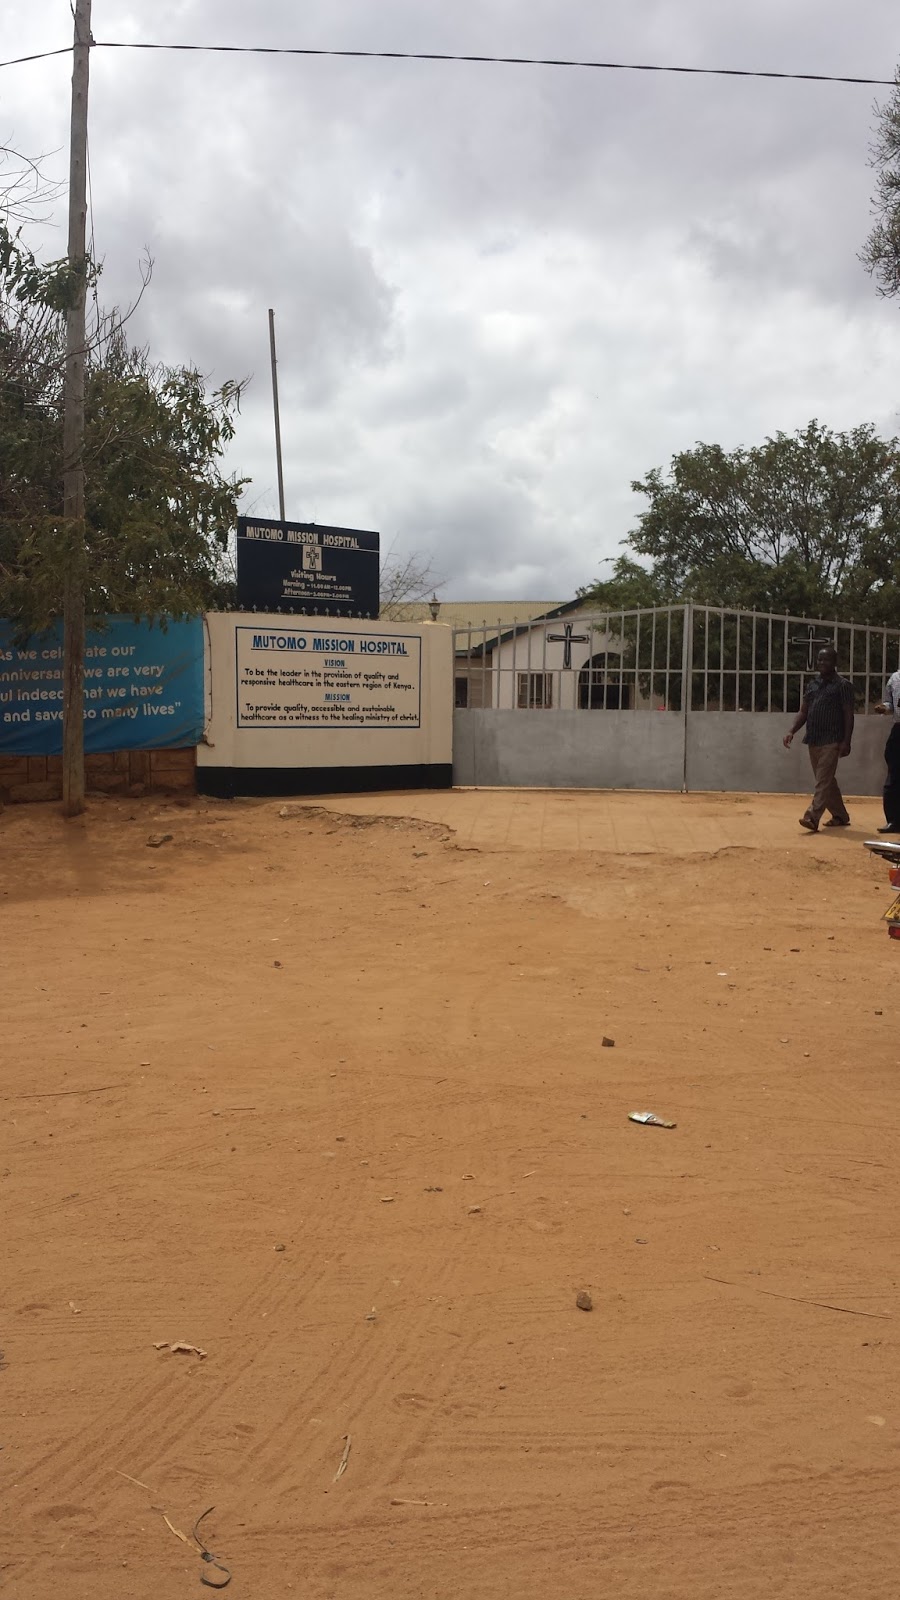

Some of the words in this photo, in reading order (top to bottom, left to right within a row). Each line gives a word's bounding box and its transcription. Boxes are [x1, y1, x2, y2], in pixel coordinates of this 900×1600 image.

[247, 526, 283, 540] MUTOMO
[288, 531, 318, 544] MISSION
[323, 534, 359, 548] HOSPITAL
[291, 570, 314, 581] Visiting
[316, 573, 336, 581] Hours
[283, 579, 305, 589] Morning
[253, 636, 306, 649] MUTOMO
[313, 639, 354, 652] MISSION
[360, 642, 407, 654] HOSPITAL
[17, 650, 37, 660] we
[111, 646, 135, 656] our
[0, 669, 64, 682] nniversa
[83, 668, 103, 678] we
[107, 667, 129, 677] are
[133, 665, 165, 677] very
[324, 672, 352, 681] provision
[364, 672, 385, 681] quality
[241, 678, 275, 686] responsive
[323, 679, 334, 687] the
[363, 681, 381, 690] region
[393, 682, 414, 690] Kenya.
[107, 687, 126, 698] we
[130, 684, 163, 696] have
[3, 708, 30, 722] and
[35, 710, 64, 721] save
[82, 709, 97, 720] so
[101, 707, 139, 719] many
[143, 701, 181, 716] lives"
[255, 704, 280, 713] provide
[284, 705, 310, 713] quality,
[342, 714, 364, 722] healing
[366, 714, 389, 722] ministry
